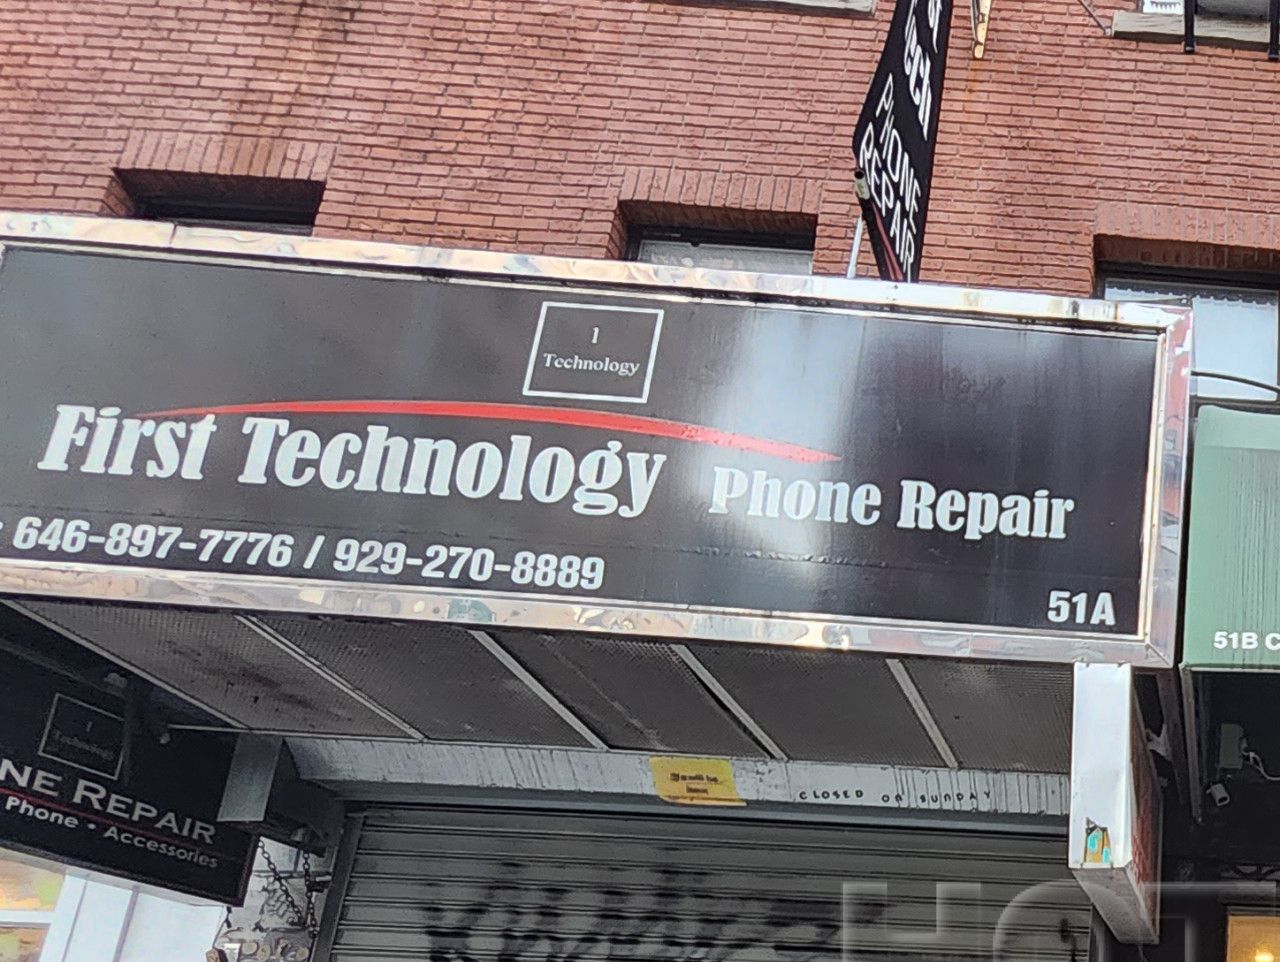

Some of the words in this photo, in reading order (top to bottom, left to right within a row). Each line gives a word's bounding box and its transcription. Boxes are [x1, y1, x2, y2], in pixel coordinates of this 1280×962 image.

[876, 73, 922, 235] PHONE
[543, 352, 640, 377] Technology
[36, 403, 218, 481] First
[237, 415, 667, 519] Technology
[708, 465, 882, 527] Phone
[896, 478, 1075, 541] Repair
[12, 515, 294, 569] 646-897-7776
[332, 538, 605, 591] 929-270-8889
[1046, 590, 1116, 626] 51A
[1213, 631, 1258, 650] 51B
[4, 796, 79, 829] Phone
[103, 826, 219, 869] Accessories
[72, 778, 217, 845] REPAIR
